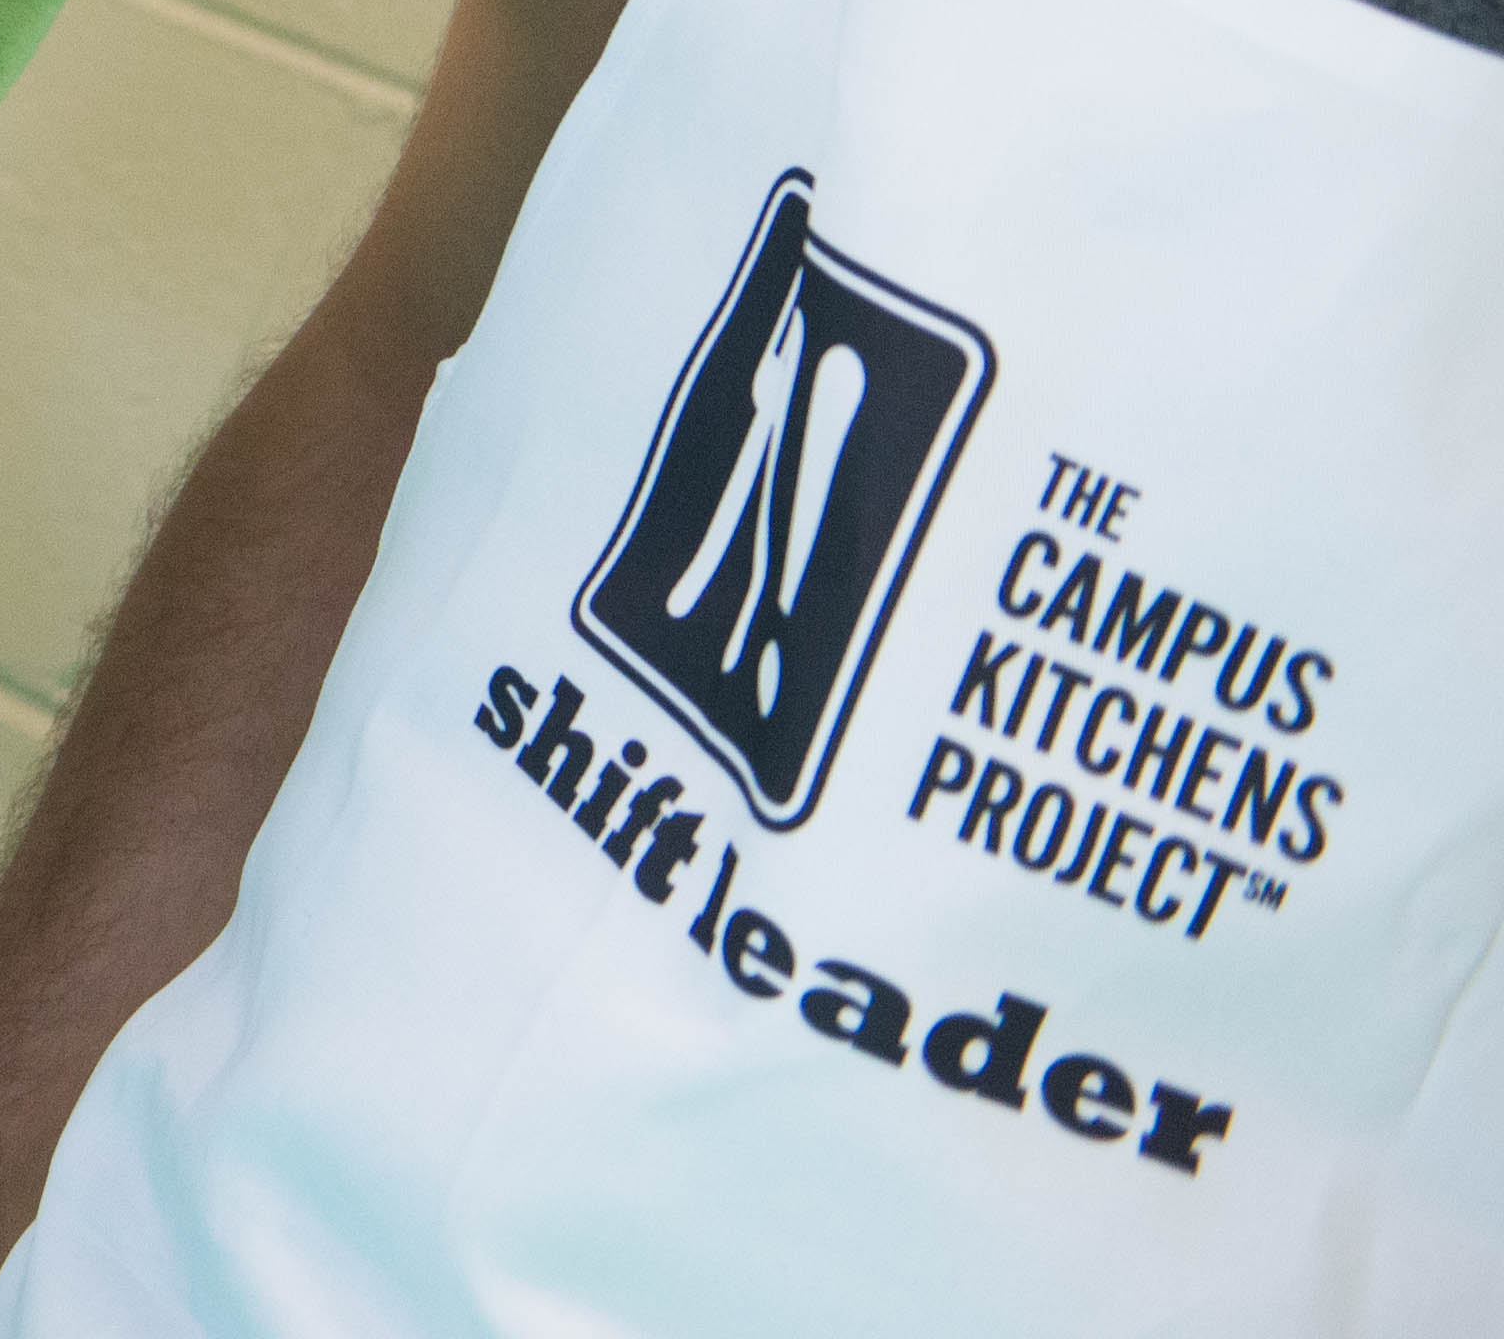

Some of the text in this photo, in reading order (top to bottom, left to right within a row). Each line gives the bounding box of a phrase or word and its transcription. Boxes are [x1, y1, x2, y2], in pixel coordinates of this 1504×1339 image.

[1038, 451, 1142, 543] THE
[996, 528, 1336, 736] CAMPUS
[949, 628, 1345, 864] KITCHENS
[473, 663, 1236, 1178] shift leader
